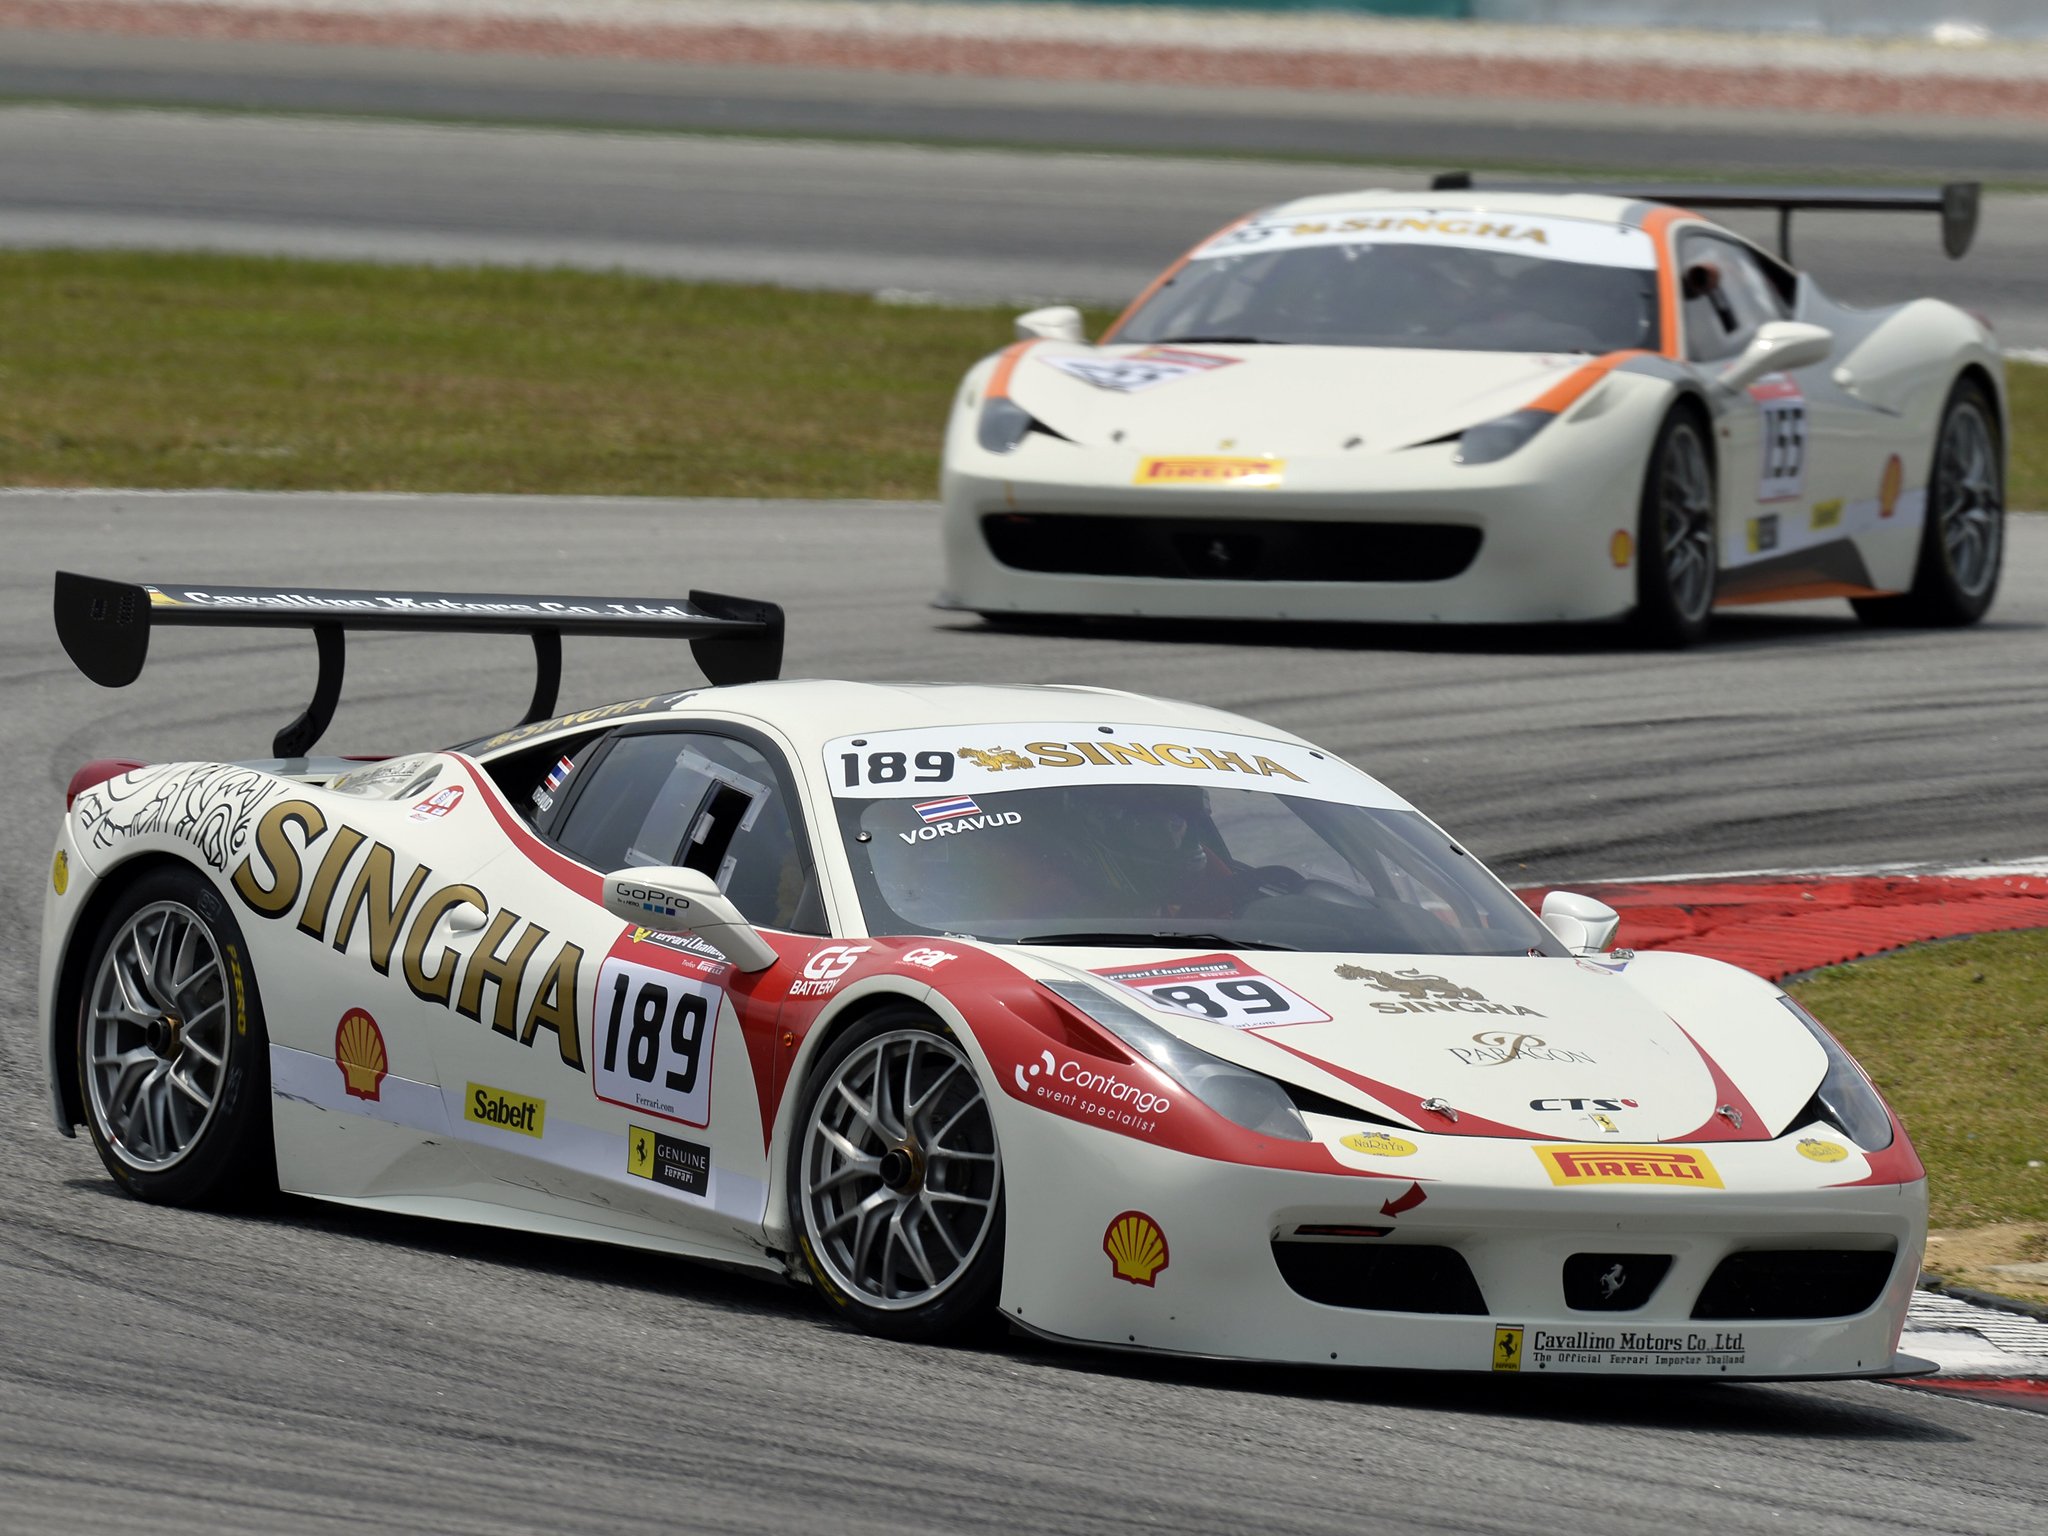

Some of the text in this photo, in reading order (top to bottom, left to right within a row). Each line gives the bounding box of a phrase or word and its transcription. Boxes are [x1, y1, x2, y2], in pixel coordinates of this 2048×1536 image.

[1335, 217, 1549, 245] SINGHA
[841, 741, 1310, 787] 189 SINGHA
[900, 810, 1023, 845] VORAVUD
[616, 882, 690, 909] GoPro
[230, 799, 587, 1074] SINGHA
[697, 960, 726, 975] PIRELLI
[803, 945, 872, 979] GS
[789, 978, 841, 996] BATTERY
[1151, 980, 1291, 1019] 89
[1368, 1000, 1549, 1019] SINGHA
[603, 972, 708, 1095] 189
[1447, 1047, 1598, 1066] PARAGON
[1059, 1061, 1171, 1114] Contango
[473, 1089, 537, 1132] Sabelt
[635, 1093, 675, 1114] Ferrari.com
[1037, 1086, 1156, 1132] event specialist
[1529, 1098, 1622, 1111] CTS
[657, 1144, 706, 1170] GENUINE
[1551, 1151, 1705, 1179] PIRELLI
[664, 1164, 694, 1184] Ferrari
[1534, 1331, 1615, 1350] Cavallino
[1620, 1332, 1682, 1350] Motors
[1533, 1352, 1745, 1367] The Official Ferrari Importer Thailand
